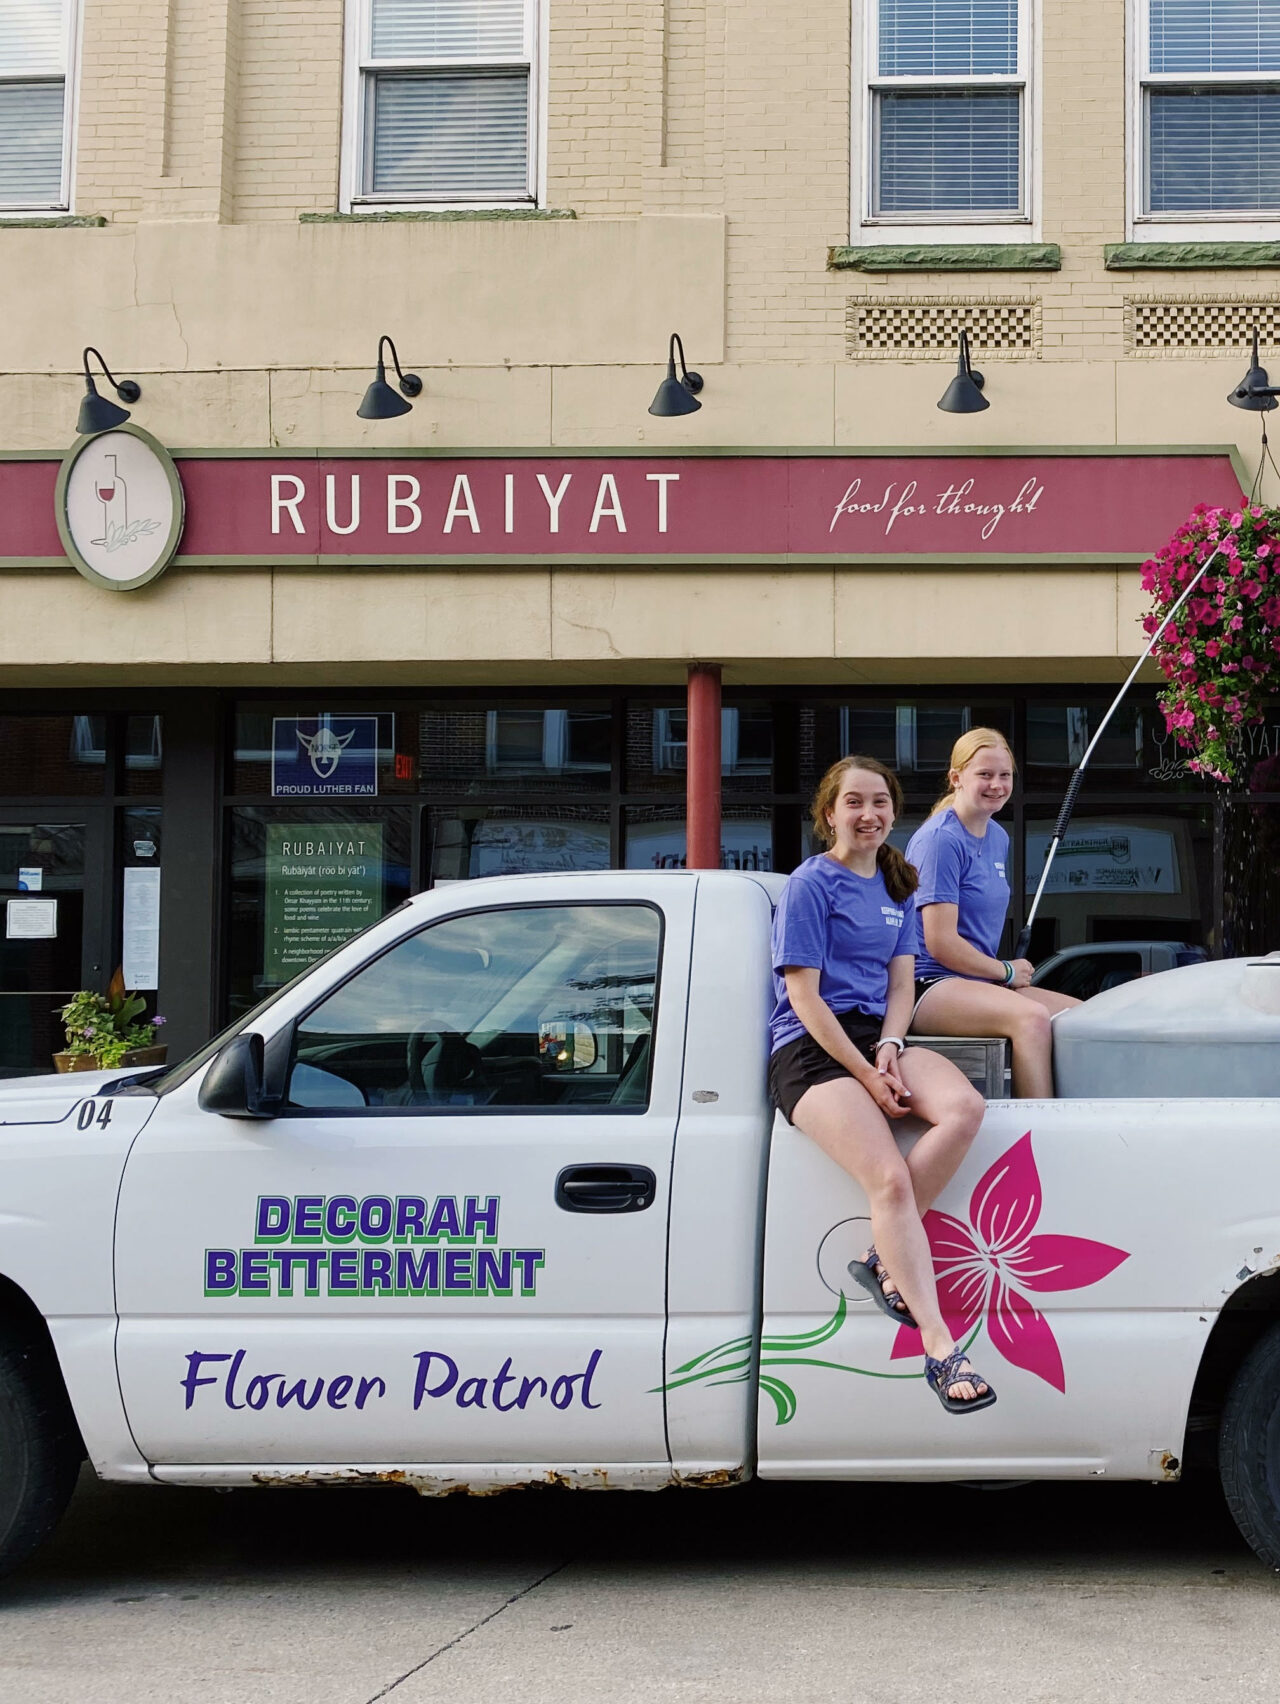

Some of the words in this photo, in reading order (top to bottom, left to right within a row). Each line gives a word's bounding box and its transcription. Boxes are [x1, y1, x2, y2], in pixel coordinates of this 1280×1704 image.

[270, 473, 680, 535] RUBAIYAT
[829, 478, 897, 533] food
[885, 480, 927, 536] for
[933, 477, 1044, 540] thought
[395, 753, 413, 779] EXIT
[276, 785, 311, 794] PROUD
[313, 784, 352, 794] LUTHER
[354, 784, 374, 793] FAN
[282, 841, 366, 856] RUBAIYAT
[320, 889, 337, 897] poetry
[356, 889, 363, 897] by
[299, 906, 317, 914] poems
[288, 948, 323, 956] neighborhood
[77, 1099, 114, 1131] 04
[254, 1195, 500, 1244] DECORAH
[204, 1248, 545, 1297] BETTERMENT
[180, 1348, 386, 1411] Flower
[412, 1348, 603, 1411] Patrol
